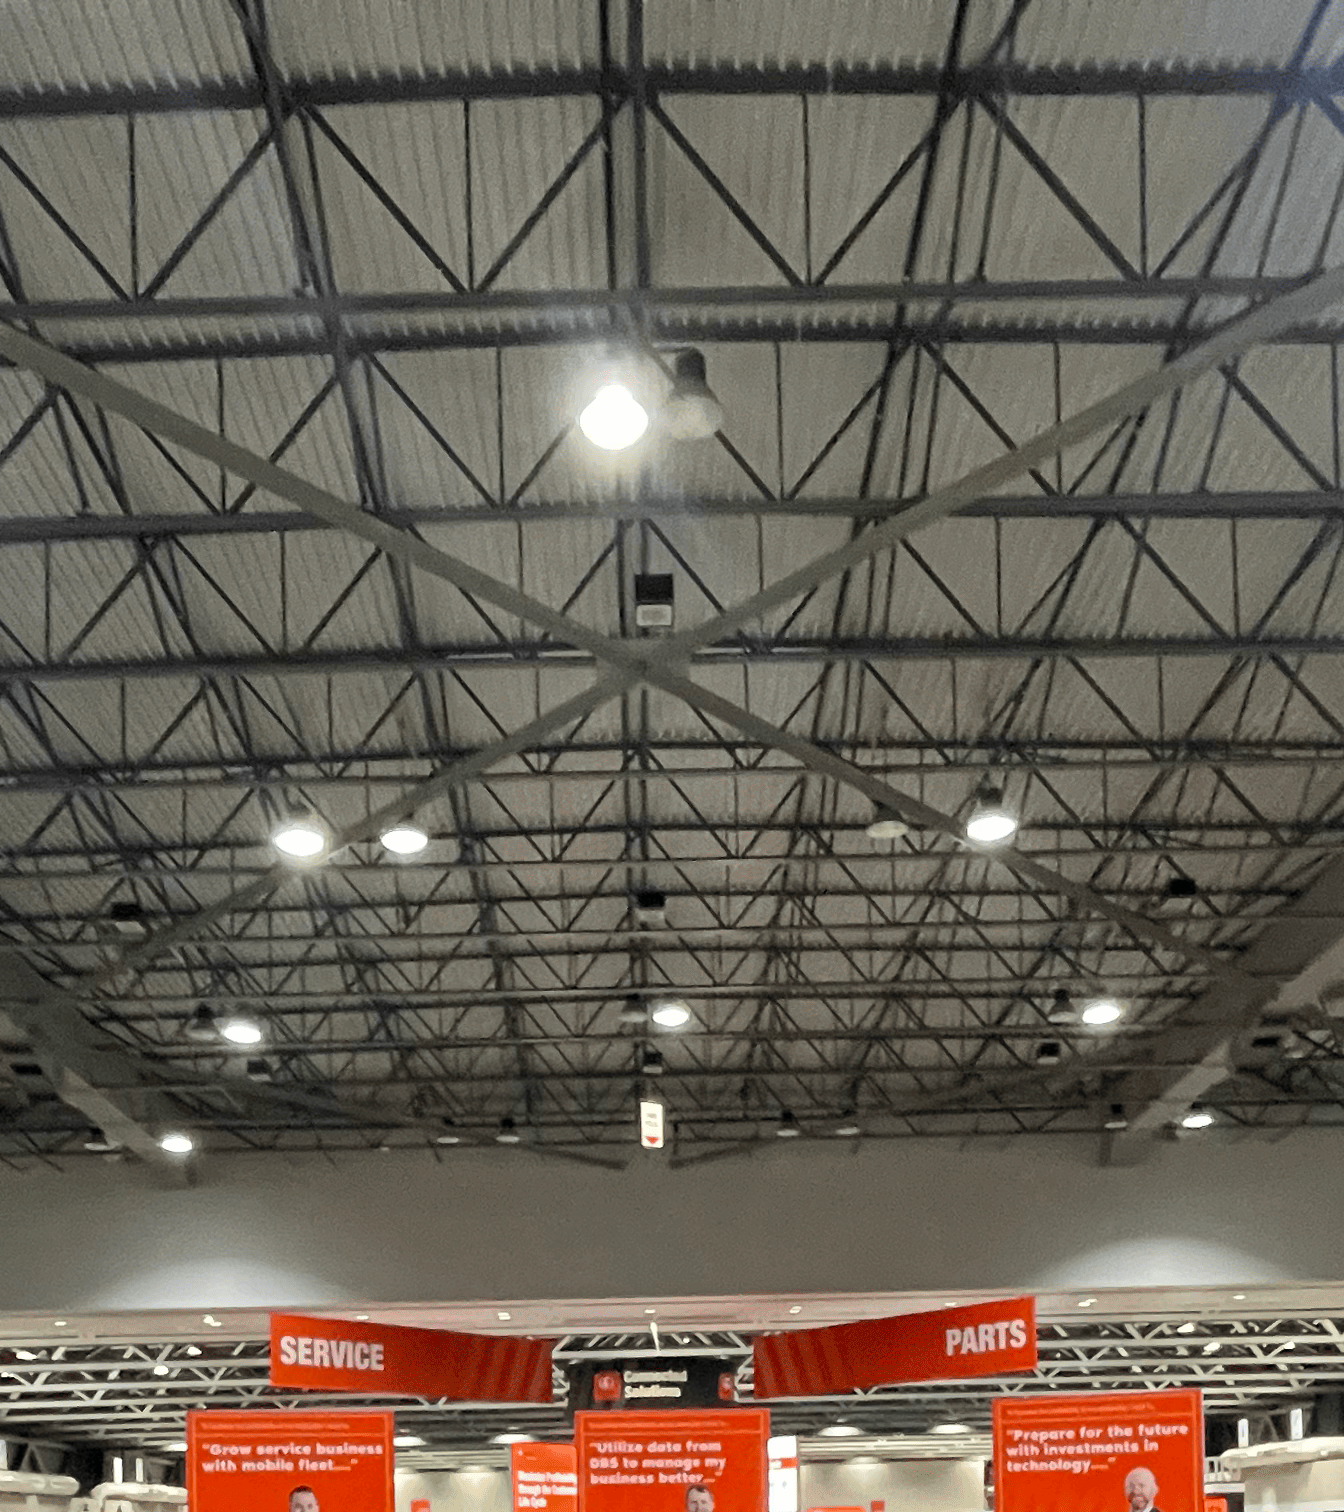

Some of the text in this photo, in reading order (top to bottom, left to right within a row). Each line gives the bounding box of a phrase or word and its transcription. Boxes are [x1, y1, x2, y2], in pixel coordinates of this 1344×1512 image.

[945, 1318, 1027, 1356] PARTS
[280, 1335, 385, 1372] SERVICE
[1079, 1426, 1103, 1438] for
[1107, 1425, 1133, 1438] the
[1138, 1424, 1188, 1437] future
[256, 1442, 312, 1456] service
[316, 1442, 383, 1455] business
[647, 1441, 682, 1453] data
[686, 1440, 722, 1452] from
[1006, 1439, 1159, 1456] with investments in
[202, 1459, 237, 1472] with
[242, 1459, 294, 1472] mobile
[622, 1457, 638, 1469] to
[642, 1458, 701, 1471] manage
[704, 1457, 727, 1470] my
[590, 1472, 654, 1484] business
